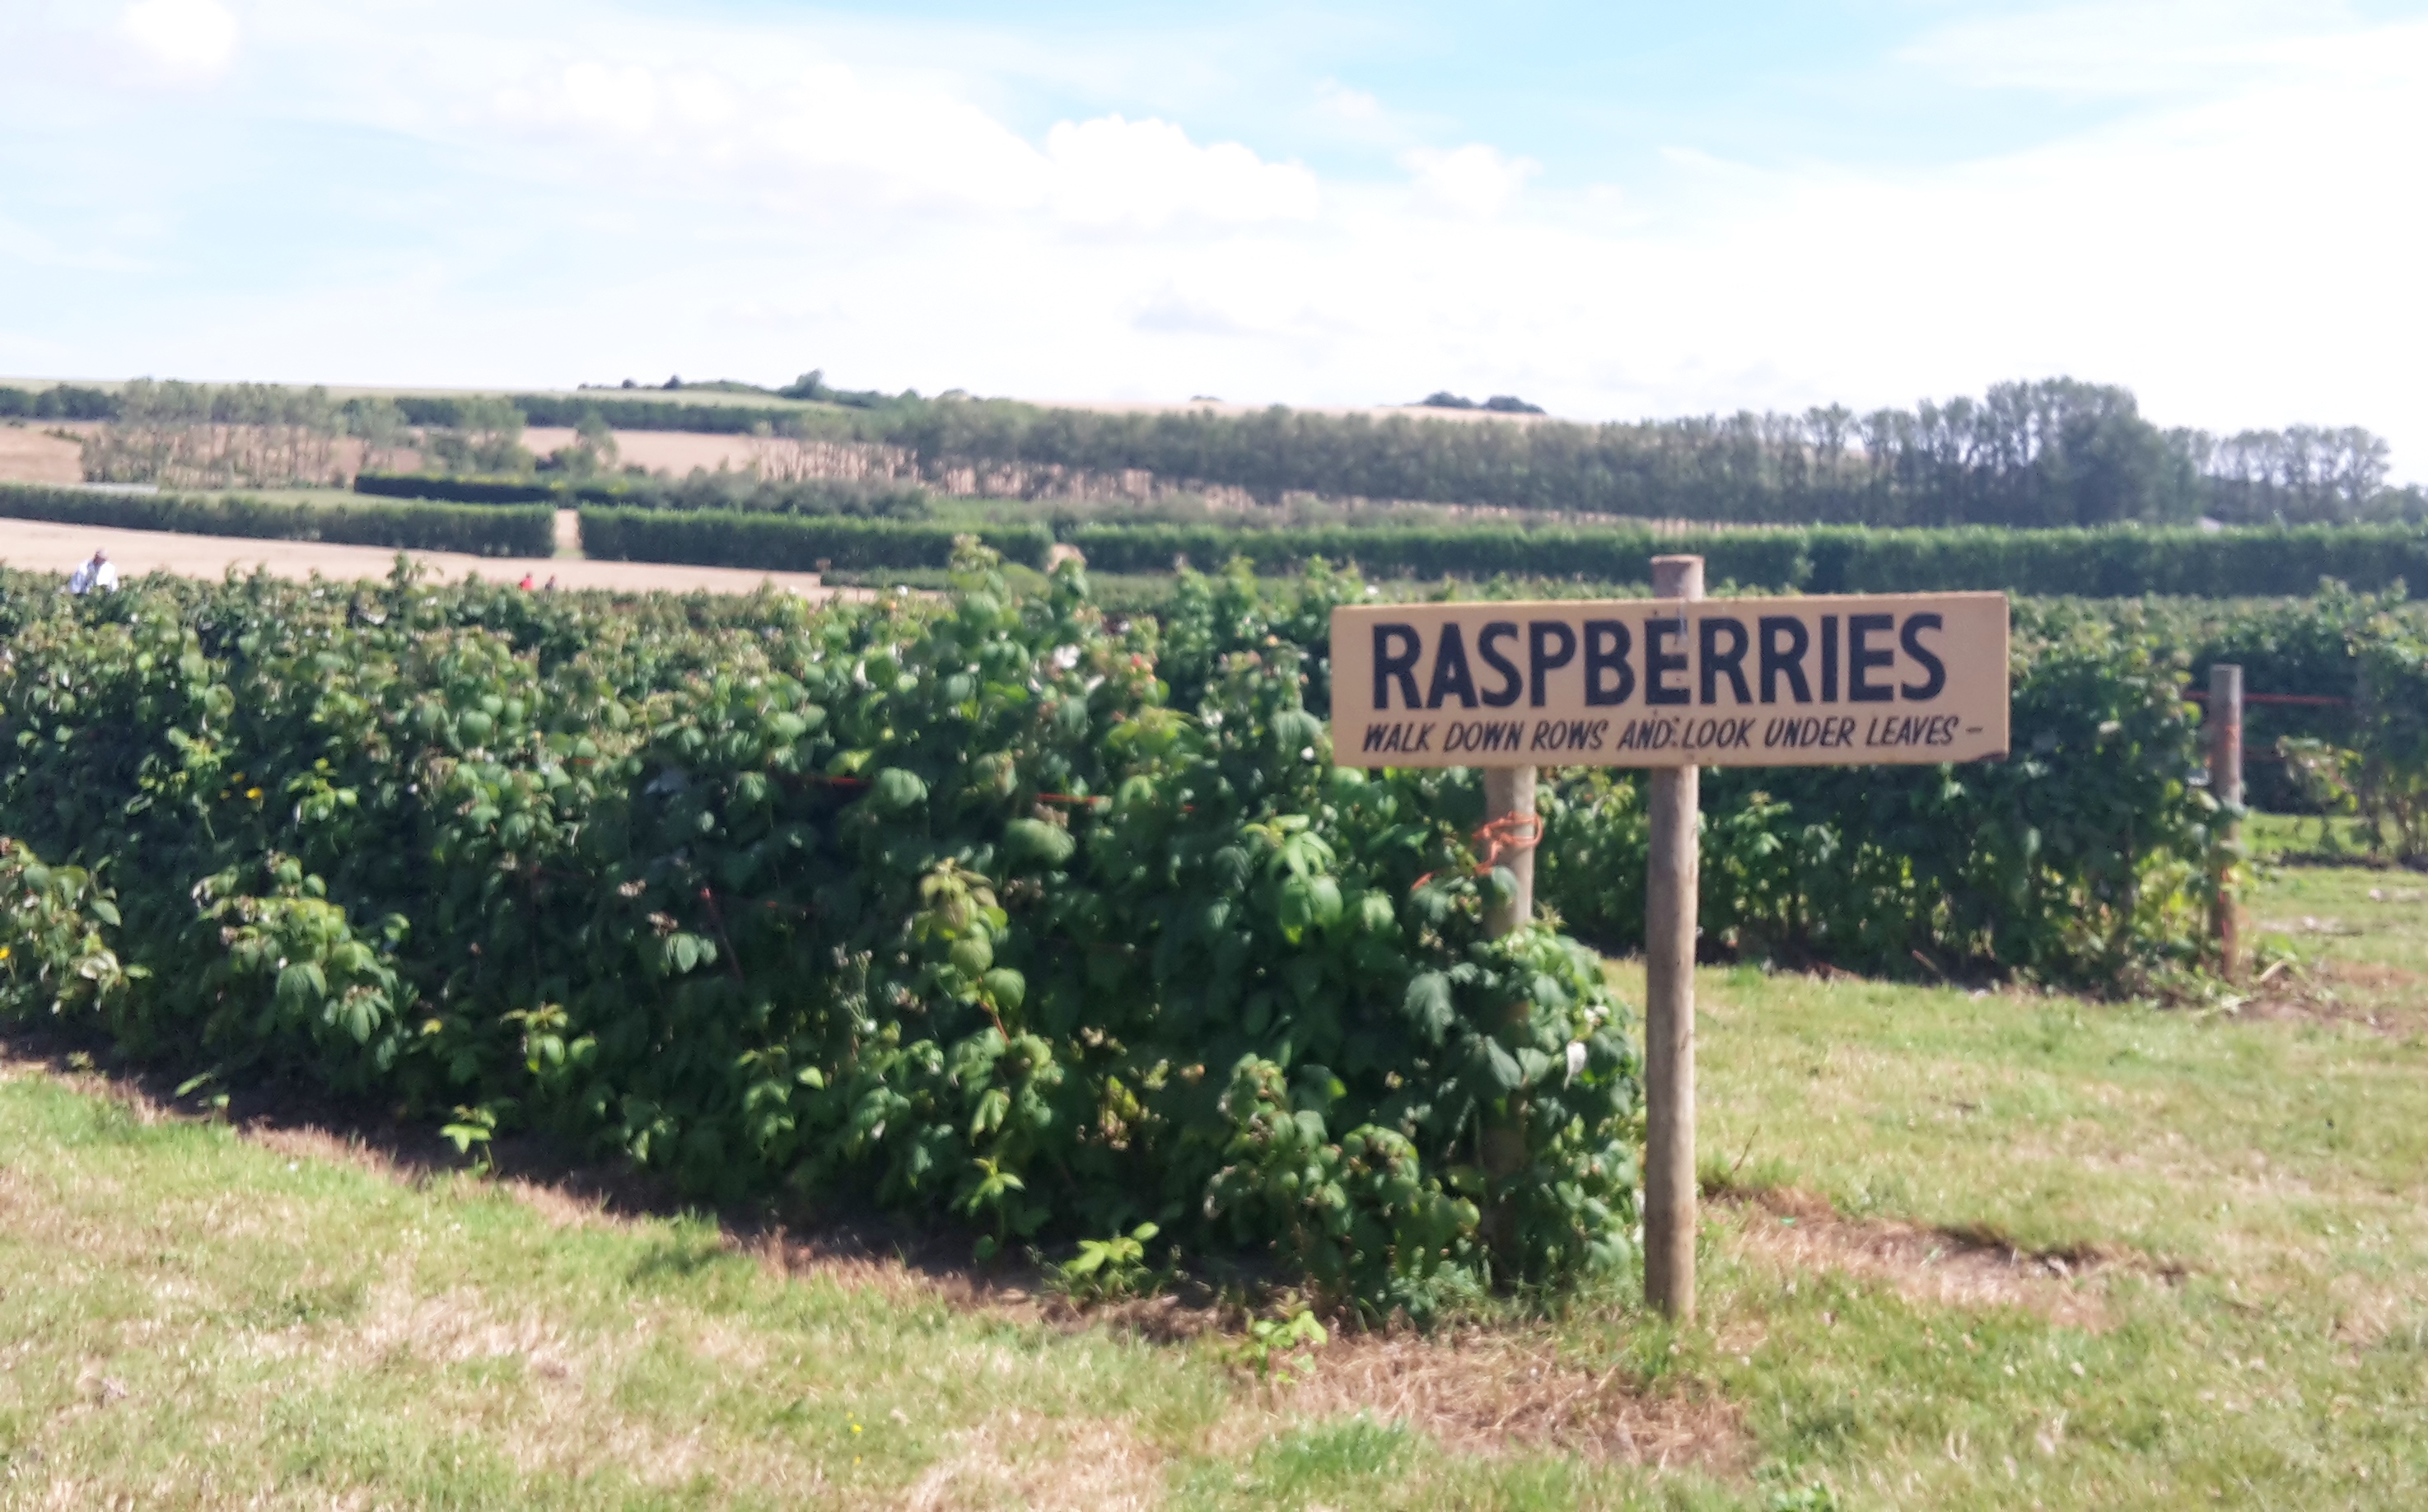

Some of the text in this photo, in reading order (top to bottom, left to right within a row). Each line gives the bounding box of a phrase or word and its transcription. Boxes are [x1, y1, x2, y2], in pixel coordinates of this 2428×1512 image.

[1371, 613, 1947, 711] RASPBERRIES
[1361, 722, 1436, 753] WALK
[1442, 721, 1525, 753] DOWN
[1530, 719, 1609, 751] ROWS
[1681, 717, 1756, 749] LOOK
[1764, 716, 1856, 748] UNDER
[1865, 715, 1959, 746] LEAVES
